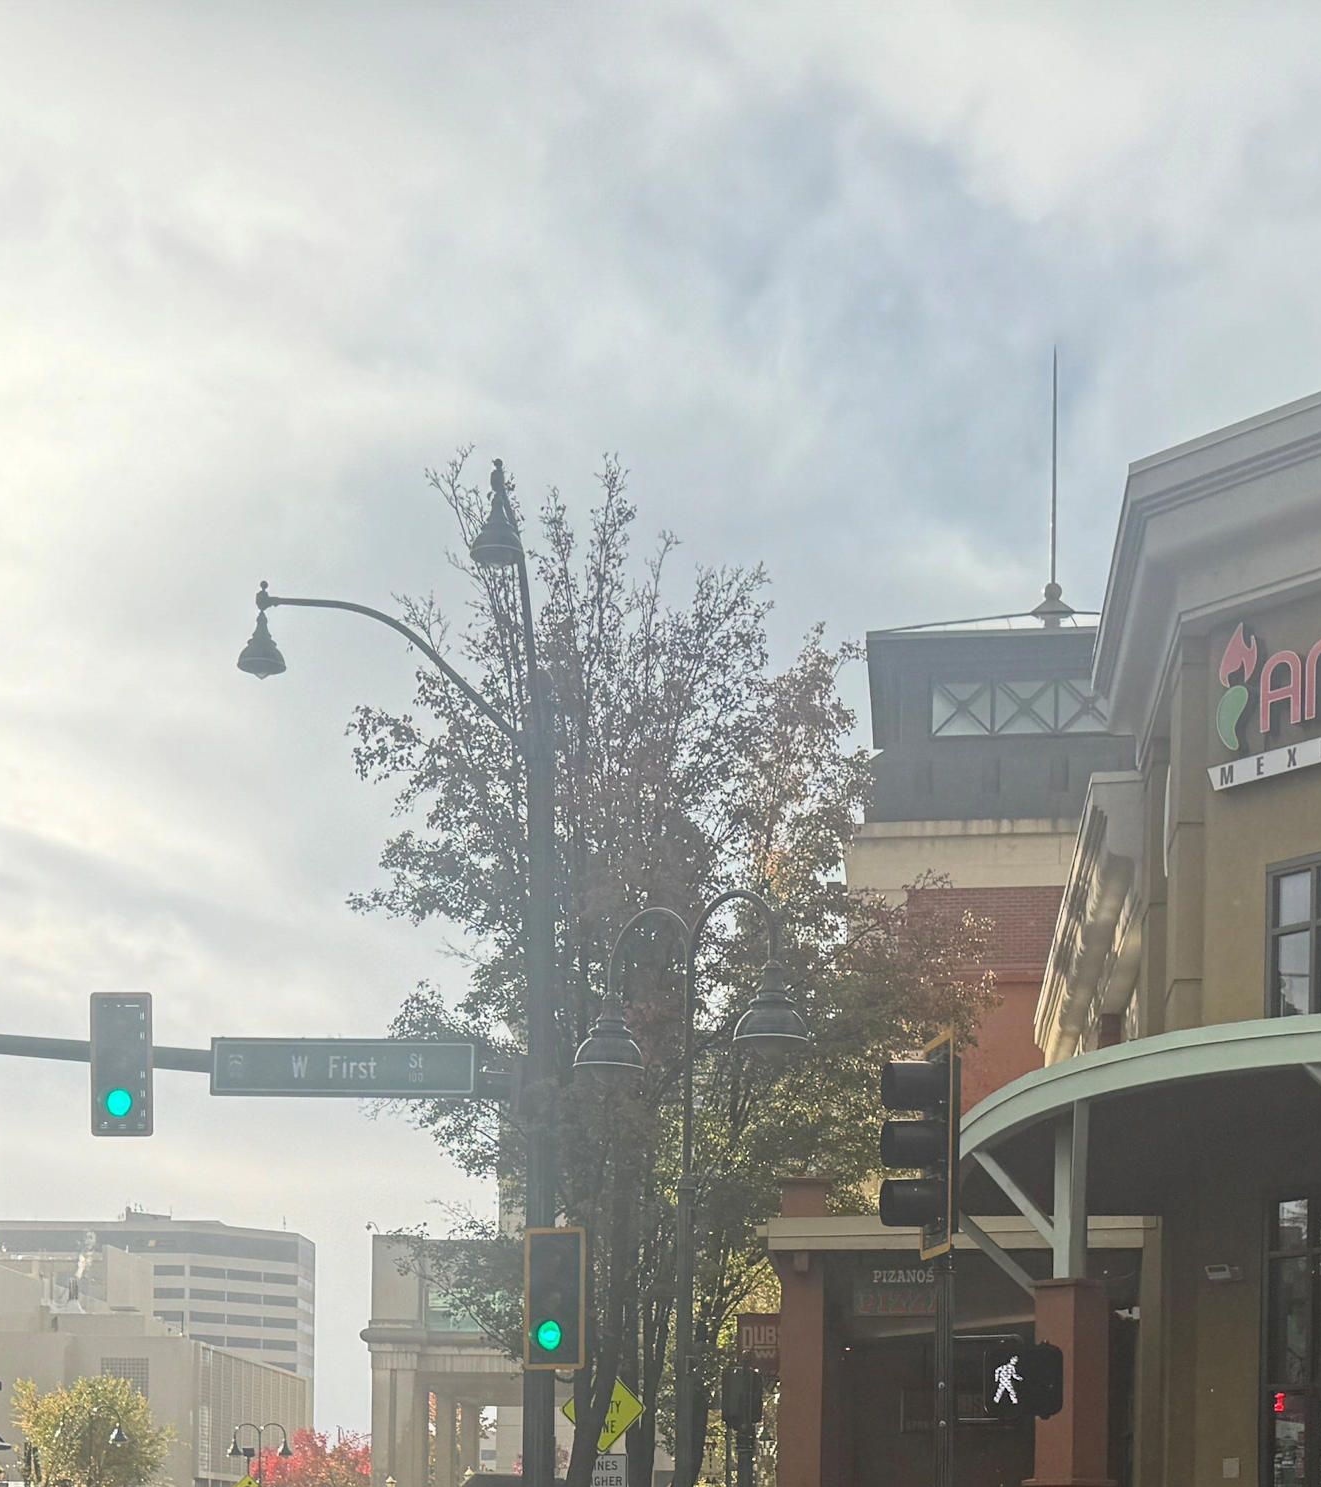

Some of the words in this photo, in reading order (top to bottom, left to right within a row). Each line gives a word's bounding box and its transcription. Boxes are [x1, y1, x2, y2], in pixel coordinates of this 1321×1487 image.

[291, 1055, 309, 1079] W
[328, 1055, 377, 1080] First
[408, 1053, 424, 1069] St
[593, 1460, 618, 1471] INES
[594, 1476, 623, 1487] GHER
